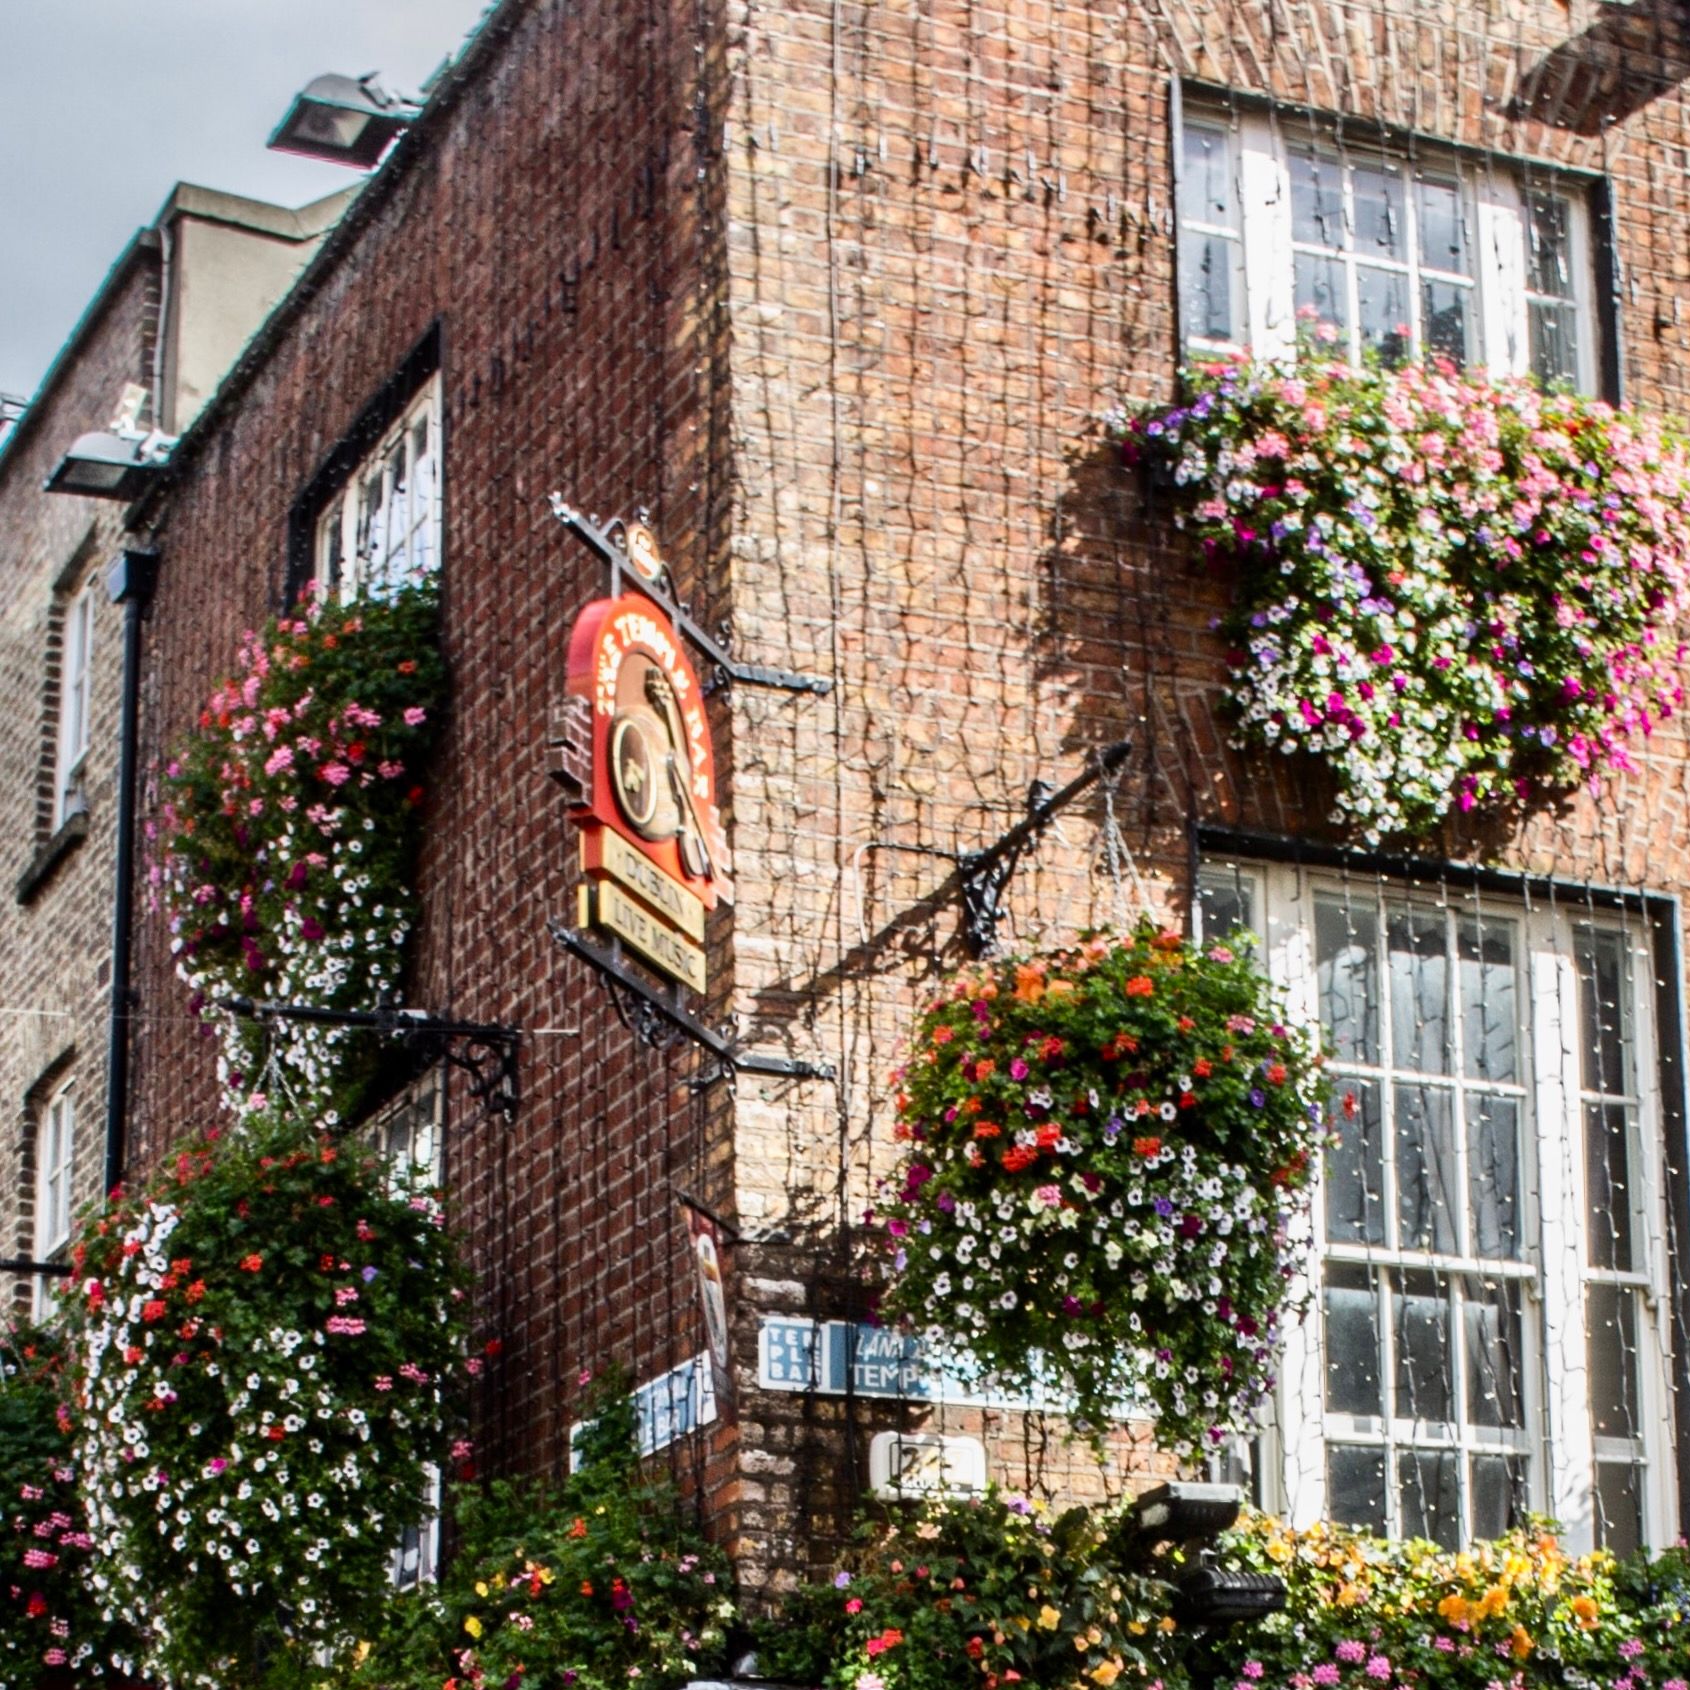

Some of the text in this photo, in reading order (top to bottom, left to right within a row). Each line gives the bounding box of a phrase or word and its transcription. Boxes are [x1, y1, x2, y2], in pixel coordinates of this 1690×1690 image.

[625, 850, 684, 918] DUBLIN
[614, 897, 697, 979] LIVE MUSIC
[853, 1362, 918, 1389] TEMP
